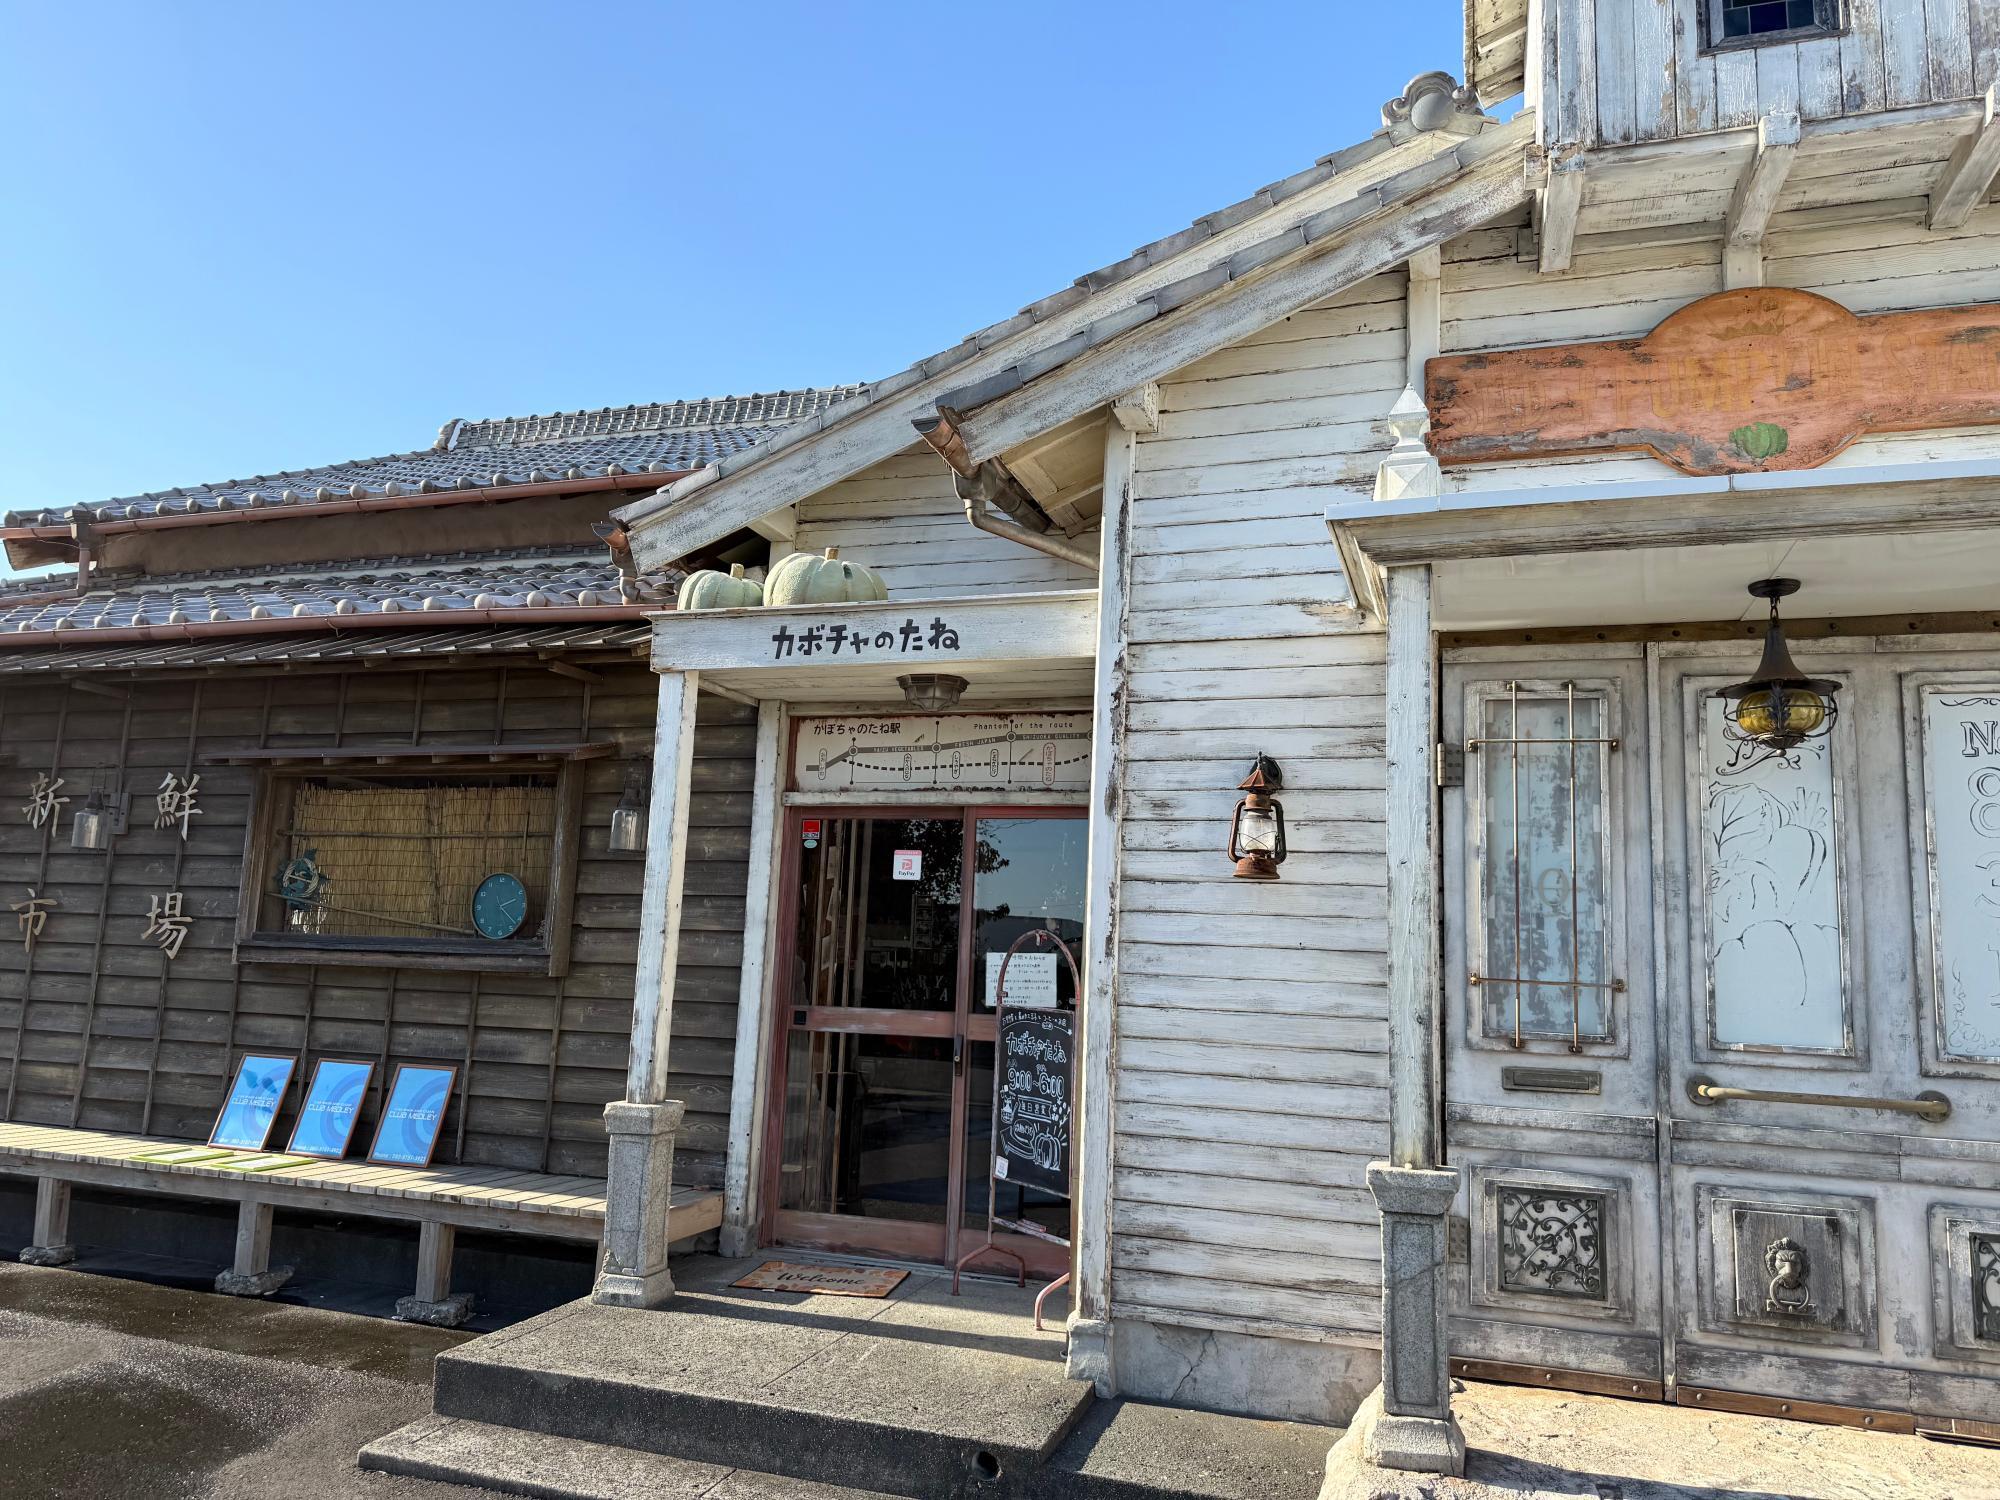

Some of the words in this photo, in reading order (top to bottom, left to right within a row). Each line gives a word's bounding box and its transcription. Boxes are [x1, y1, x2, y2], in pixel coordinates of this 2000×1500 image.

[772, 617, 960, 660] カボチャのたね
[813, 722, 901, 735] かぼちゃのたね駅
[231, 1097, 250, 1105] CLUB
[307, 1103, 330, 1112] CLUB
[329, 1105, 355, 1114] MEDLEY
[388, 1110, 408, 1119] CLUB
[407, 1112, 438, 1121] MEDLEY
[777, 1272, 865, 1285] Welcome
